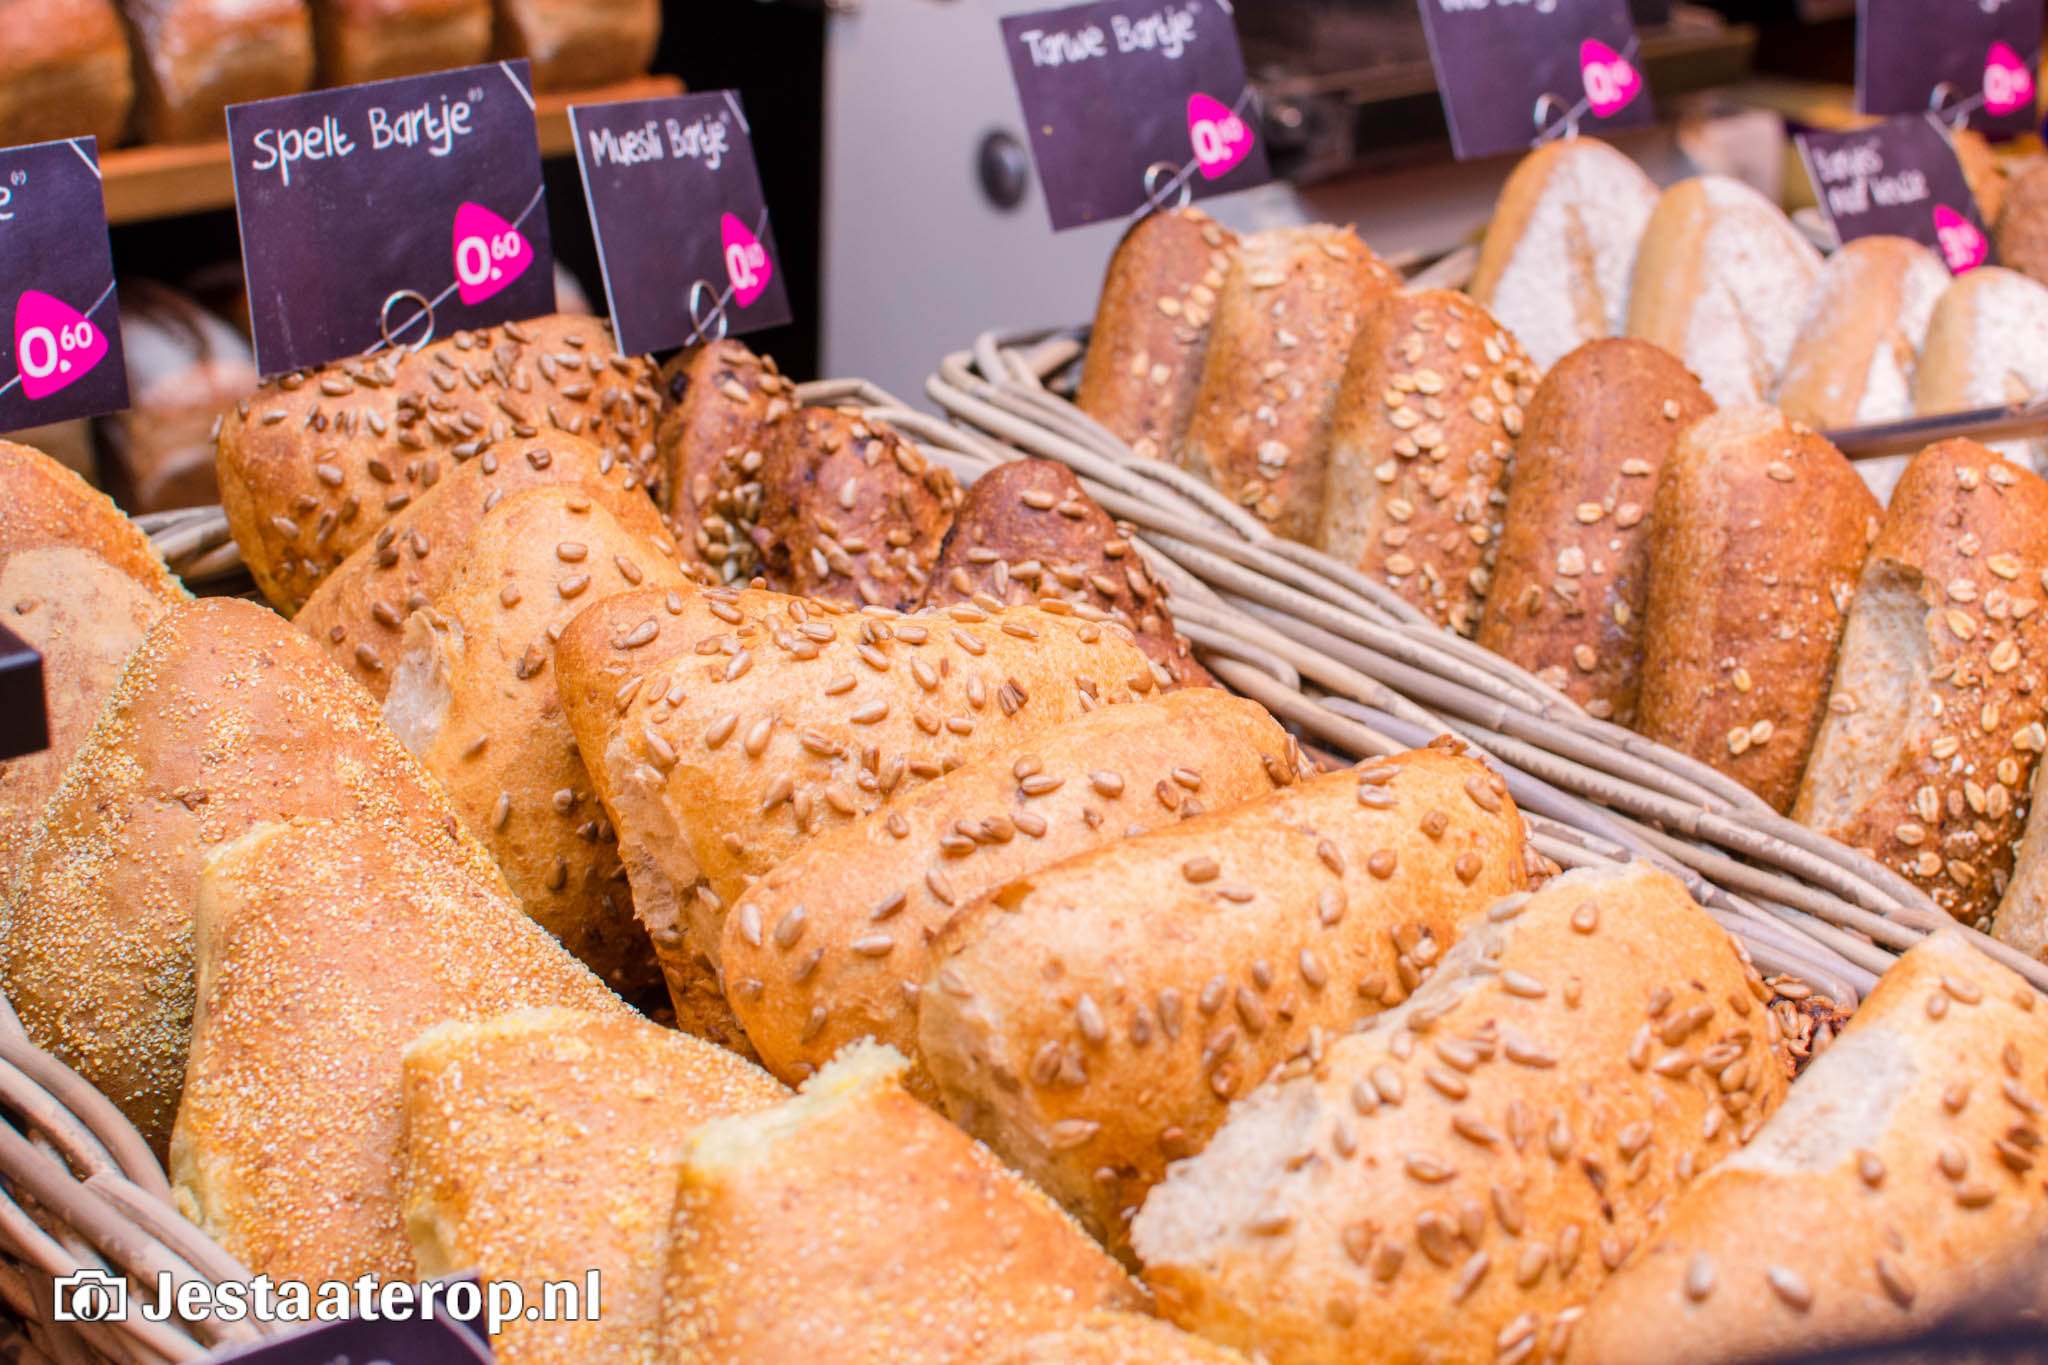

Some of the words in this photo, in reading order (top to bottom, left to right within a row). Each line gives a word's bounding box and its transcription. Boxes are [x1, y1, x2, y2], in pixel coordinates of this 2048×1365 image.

[1583, 60, 1633, 105] 0.
[252, 115, 356, 187] Spelt
[368, 94, 473, 157] Bartje
[588, 120, 664, 168] Muesli
[665, 113, 730, 171] Bartje
[1191, 115, 1245, 165] 0.
[456, 231, 522, 286] 0.60
[19, 320, 93, 378] 0.60
